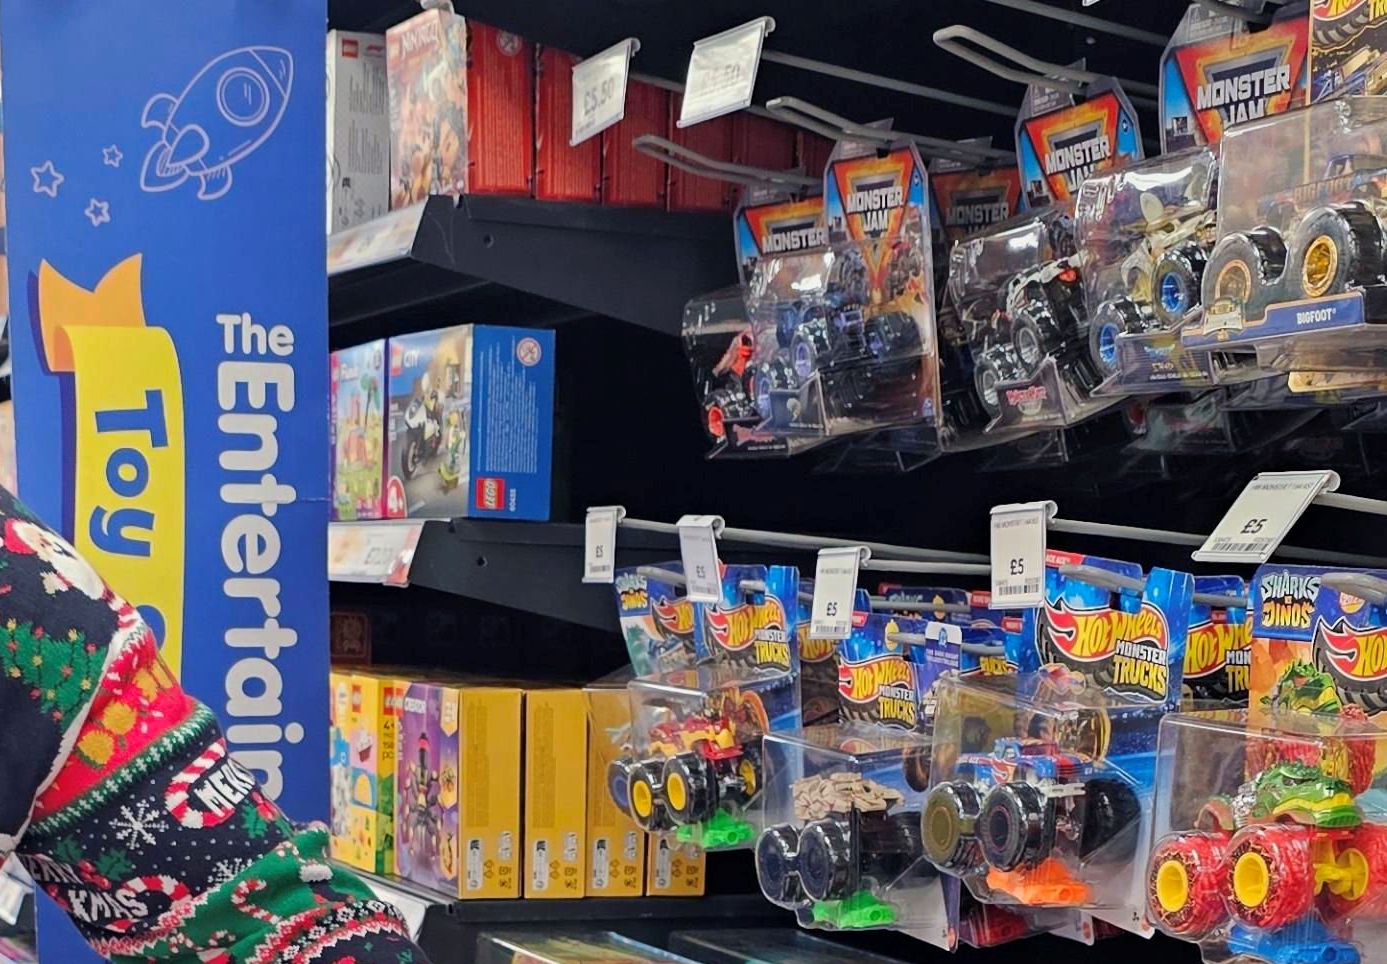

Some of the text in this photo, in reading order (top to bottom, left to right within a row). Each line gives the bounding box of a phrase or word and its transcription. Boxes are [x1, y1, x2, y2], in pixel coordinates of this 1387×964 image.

[1197, 64, 1291, 109] MONSTER
[1224, 98, 1266, 125] JAM
[1044, 135, 1110, 175] MONSTER
[847, 186, 903, 214] MONSTER
[946, 202, 1009, 226] MONSTER
[864, 209, 889, 232] JAM
[763, 227, 824, 252] MONSTER
[1297, 307, 1333, 326] BIGFOOT
[215, 312, 295, 356] The
[88, 388, 169, 557] Toy
[1240, 518, 1268, 535] £5
[1010, 557, 1025, 575] £5
[1262, 569, 1321, 600] SHARKS
[826, 602, 838, 617] £5
[1262, 602, 1316, 629] DINOS
[729, 609, 756, 647] HOT
[1075, 608, 1163, 657] HOT WHEELS
[755, 641, 789, 668] TRUCKS
[1116, 640, 1167, 663] MONSTER
[1185, 628, 1219, 675] HOT
[851, 658, 911, 699] HOT WHEELS
[1113, 655, 1168, 696] TRUCKS
[878, 684, 915, 701] MONSTER
[878, 698, 916, 726] TRUCKS
[68, 887, 150, 923] XMAS
